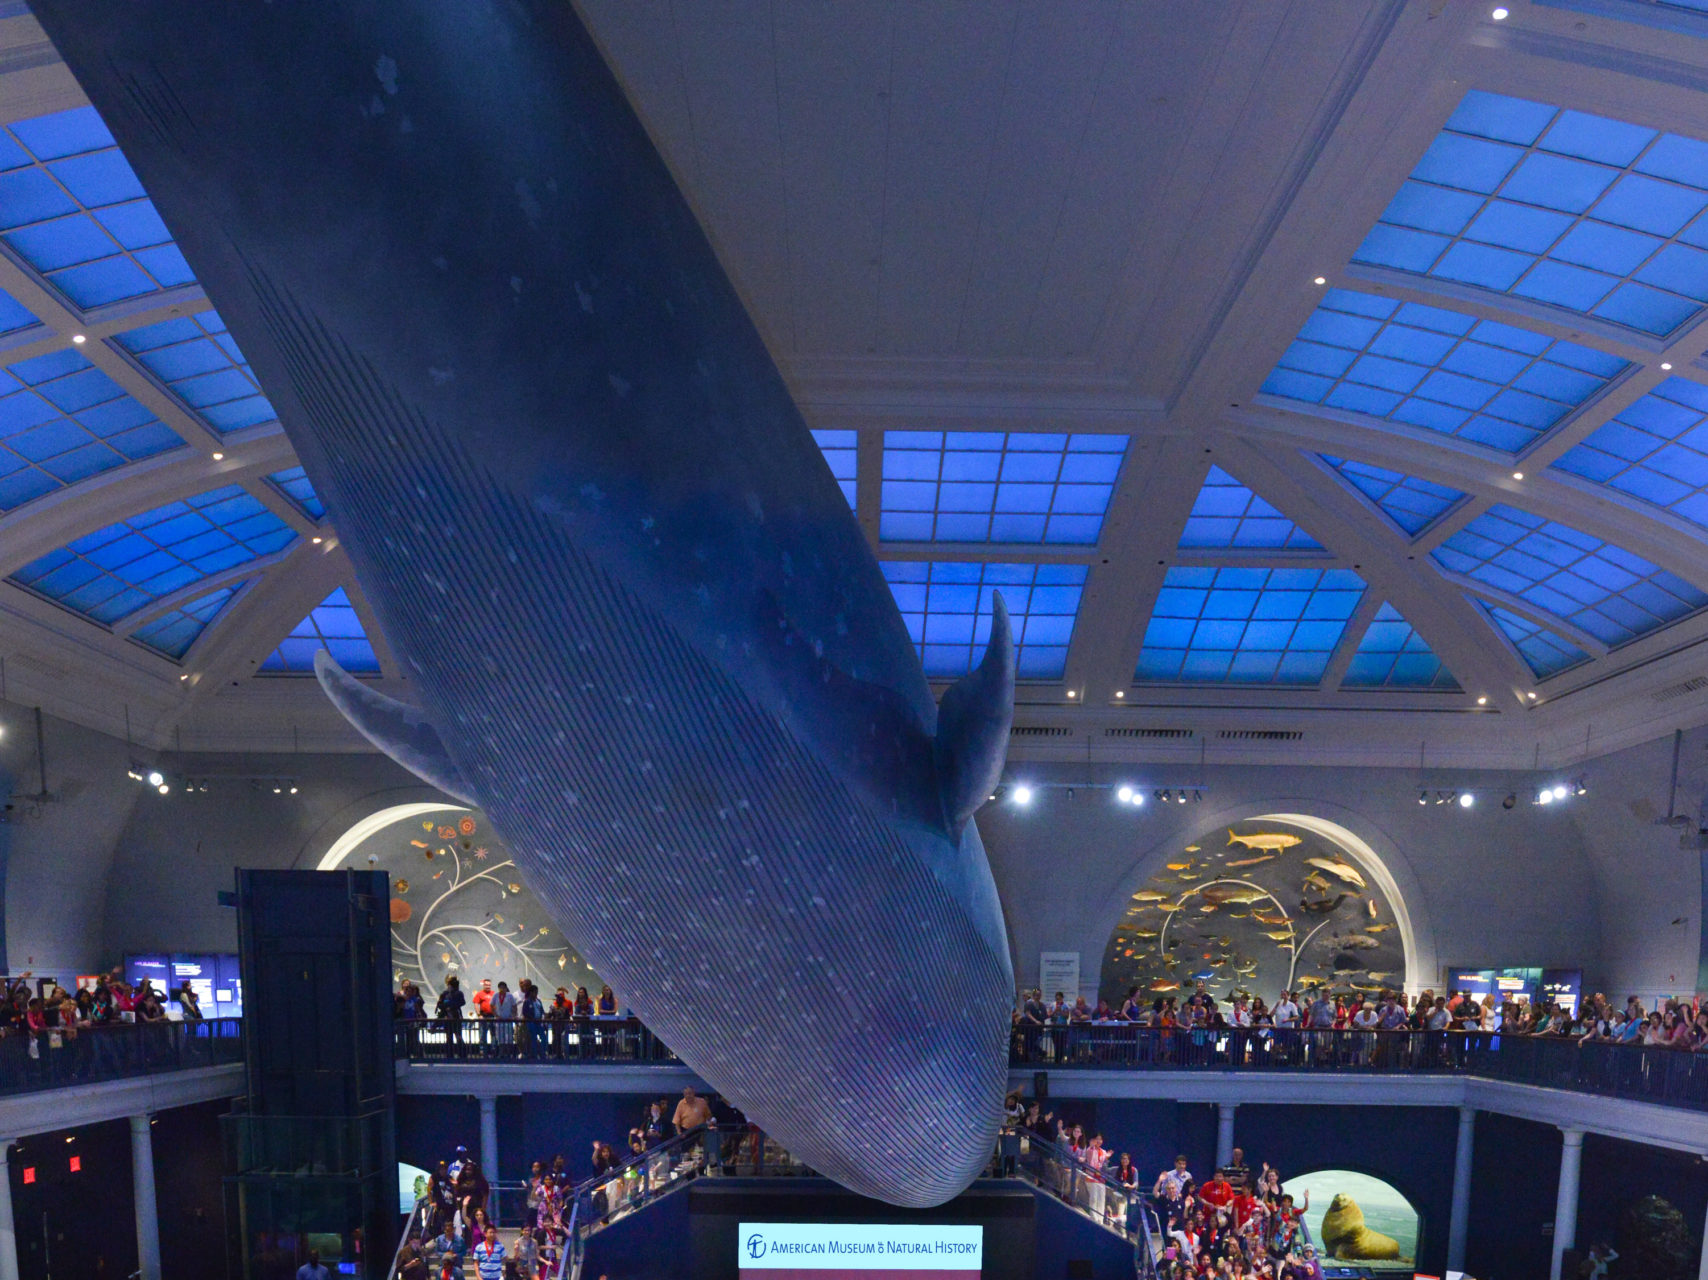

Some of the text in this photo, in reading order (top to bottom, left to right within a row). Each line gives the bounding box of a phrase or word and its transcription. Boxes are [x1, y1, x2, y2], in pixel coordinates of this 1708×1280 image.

[771, 1240, 825, 1254] AMERICAN
[828, 1241, 875, 1254] MUSEUM
[886, 1241, 933, 1254] NATURAL
[935, 1241, 978, 1255] HISTORY
